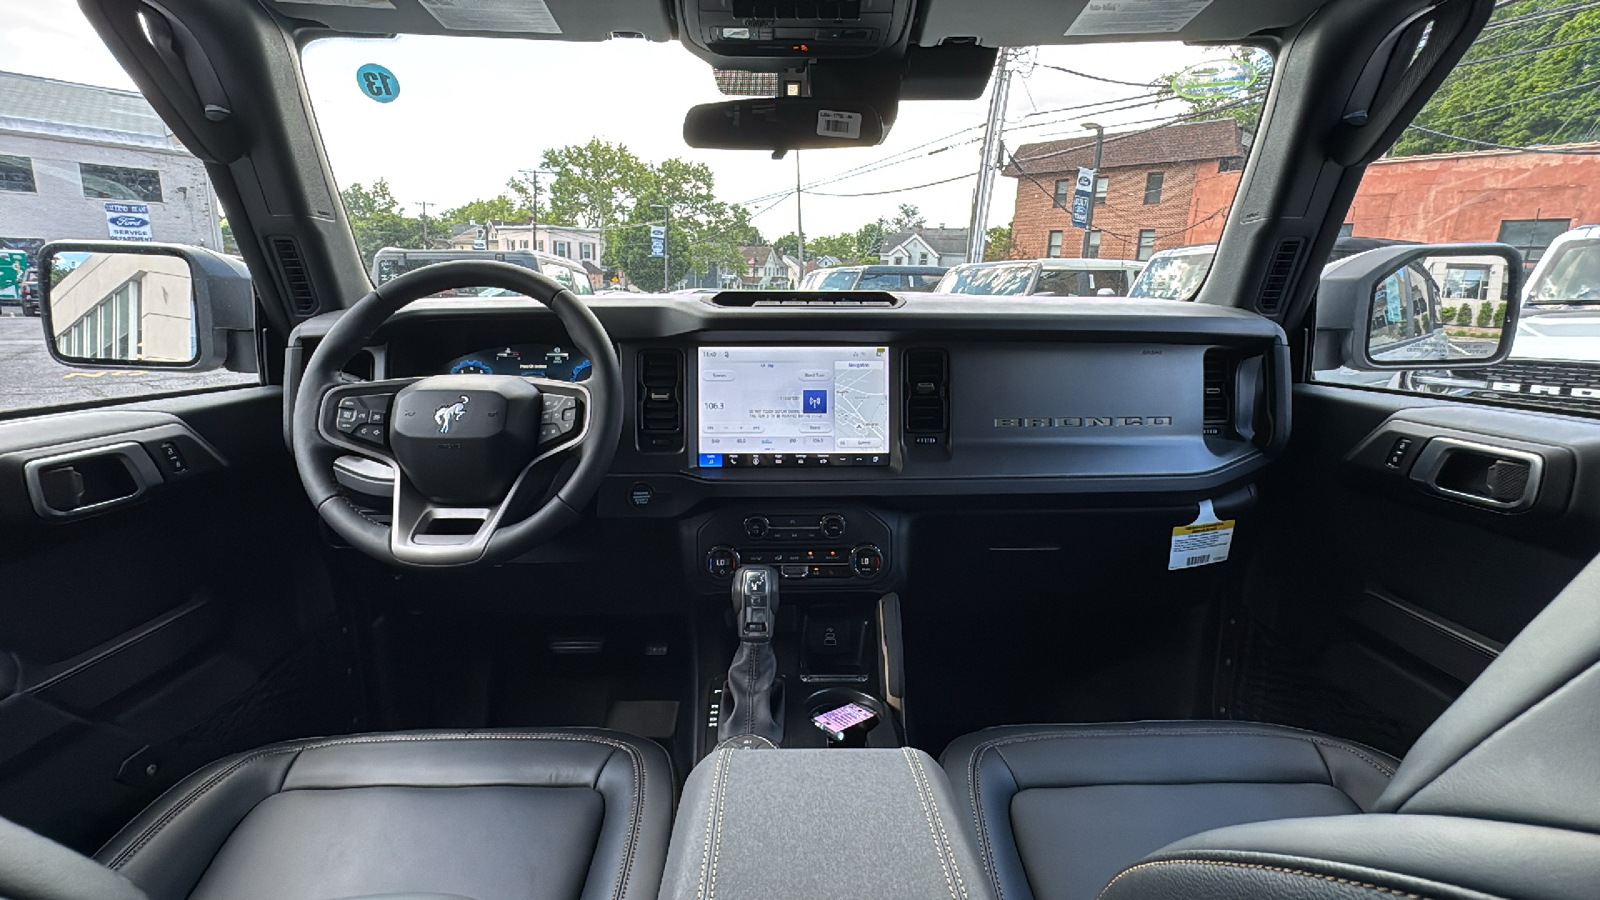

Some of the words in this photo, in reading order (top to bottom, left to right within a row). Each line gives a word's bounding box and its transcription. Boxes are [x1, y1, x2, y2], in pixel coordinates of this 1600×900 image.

[116, 217, 143, 226] Ford
[704, 402, 724, 410] 106.3
[994, 416, 1173, 428] BRONCO
